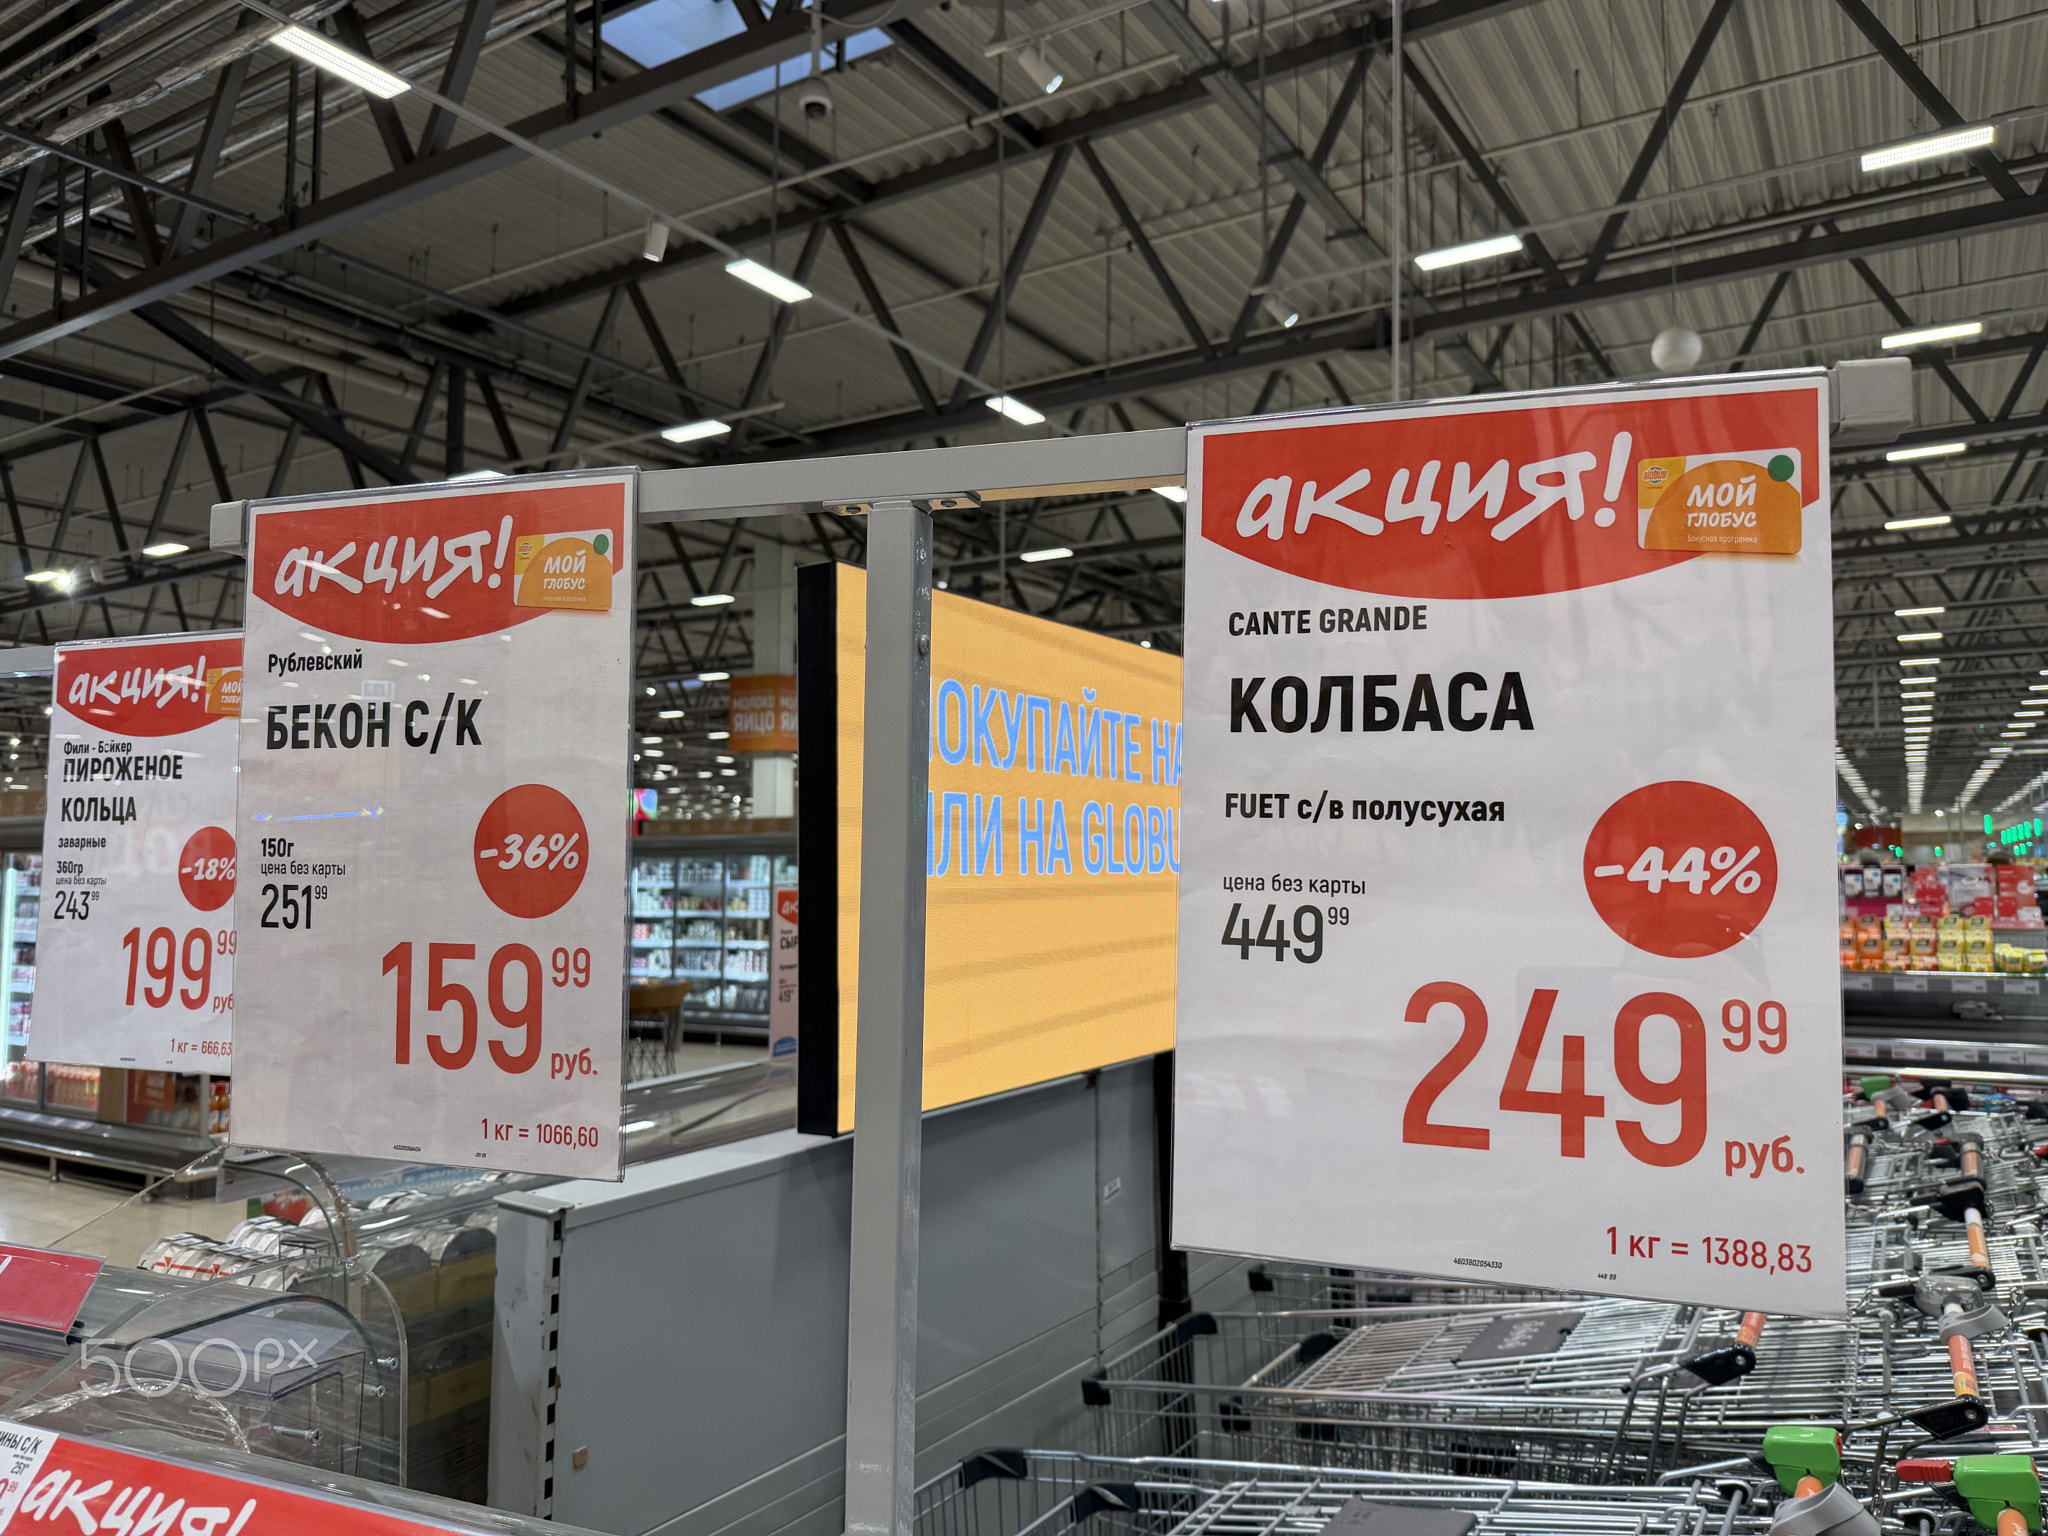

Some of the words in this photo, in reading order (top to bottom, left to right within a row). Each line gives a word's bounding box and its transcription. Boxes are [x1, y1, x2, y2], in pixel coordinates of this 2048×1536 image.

[1236, 431, 1632, 541] акция!
[1686, 475, 1756, 508] МОЙ
[1687, 511, 1757, 528] ГЛОБУС
[1687, 534, 1718, 543] бонусная
[1719, 536, 1758, 545] программа
[274, 515, 513, 599] акция!
[543, 550, 587, 574] МОЙ
[543, 577, 586, 590] ГЛОБУС
[1228, 609, 1311, 636] CANTE
[1319, 605, 1427, 633] GRANDE
[268, 649, 363, 677] Рублевский
[68, 655, 206, 709] акция!
[1230, 671, 1535, 734] КОЛБАСА
[267, 702, 391, 750] БЕКОН
[405, 692, 483, 754] С/К
[928, 677, 1142, 783] ОКУПАЙТЕ
[64, 740, 90, 755] Фили
[63, 755, 184, 782] ПИРОЖЕНОЕ
[61, 796, 137, 825] КОЛЬЦА
[1225, 792, 1290, 818] FUET
[1297, 790, 1344, 823] с/в
[1352, 800, 1505, 827] полусухая
[58, 837, 107, 850] заварные
[261, 837, 294, 857] 150г
[927, 791, 1002, 877] ЛИ
[1019, 797, 1072, 875] НА
[480, 833, 580, 870] -36%
[56, 861, 83, 876] 360гр
[56, 877, 72, 885] цена
[73, 875, 85, 885] без
[87, 877, 107, 887] карты
[181, 857, 236, 881] -18%
[261, 863, 287, 876] цена
[290, 861, 309, 875] без
[312, 863, 346, 878] карты
[1594, 845, 1761, 895] -44%
[1223, 876, 1265, 892] цена
[1271, 873, 1303, 891] без
[1309, 878, 1366, 897] карты
[54, 890, 90, 920] 243
[92, 891, 99, 900] 99
[261, 883, 312, 929] 251
[314, 885, 328, 900] 99
[1221, 903, 1324, 964] 449
[1328, 907, 1350, 925] 99
[123, 927, 212, 1010] 199
[217, 930, 237, 955] 99
[382, 941, 543, 1075] 159
[552, 947, 591, 988] 99
[171, 1038, 175, 1052] 1
[177, 1041, 189, 1053] кг
[201, 1041, 233, 1057] 666,63
[551, 1047, 598, 1080] руб.
[1402, 981, 1707, 1167] 249
[1721, 999, 1788, 1054] 99
[481, 1118, 488, 1139] 1
[495, 1124, 513, 1141] кг
[536, 1124, 599, 1150] 1066,60
[1724, 1134, 1805, 1179] руб.
[1453, 1257, 1503, 1269] 4603802054330
[1606, 1226, 1617, 1255] 1
[1629, 1234, 1661, 1258] кг
[1702, 1237, 1812, 1275] 1388,83
[20, 1436, 43, 1454] С/К
